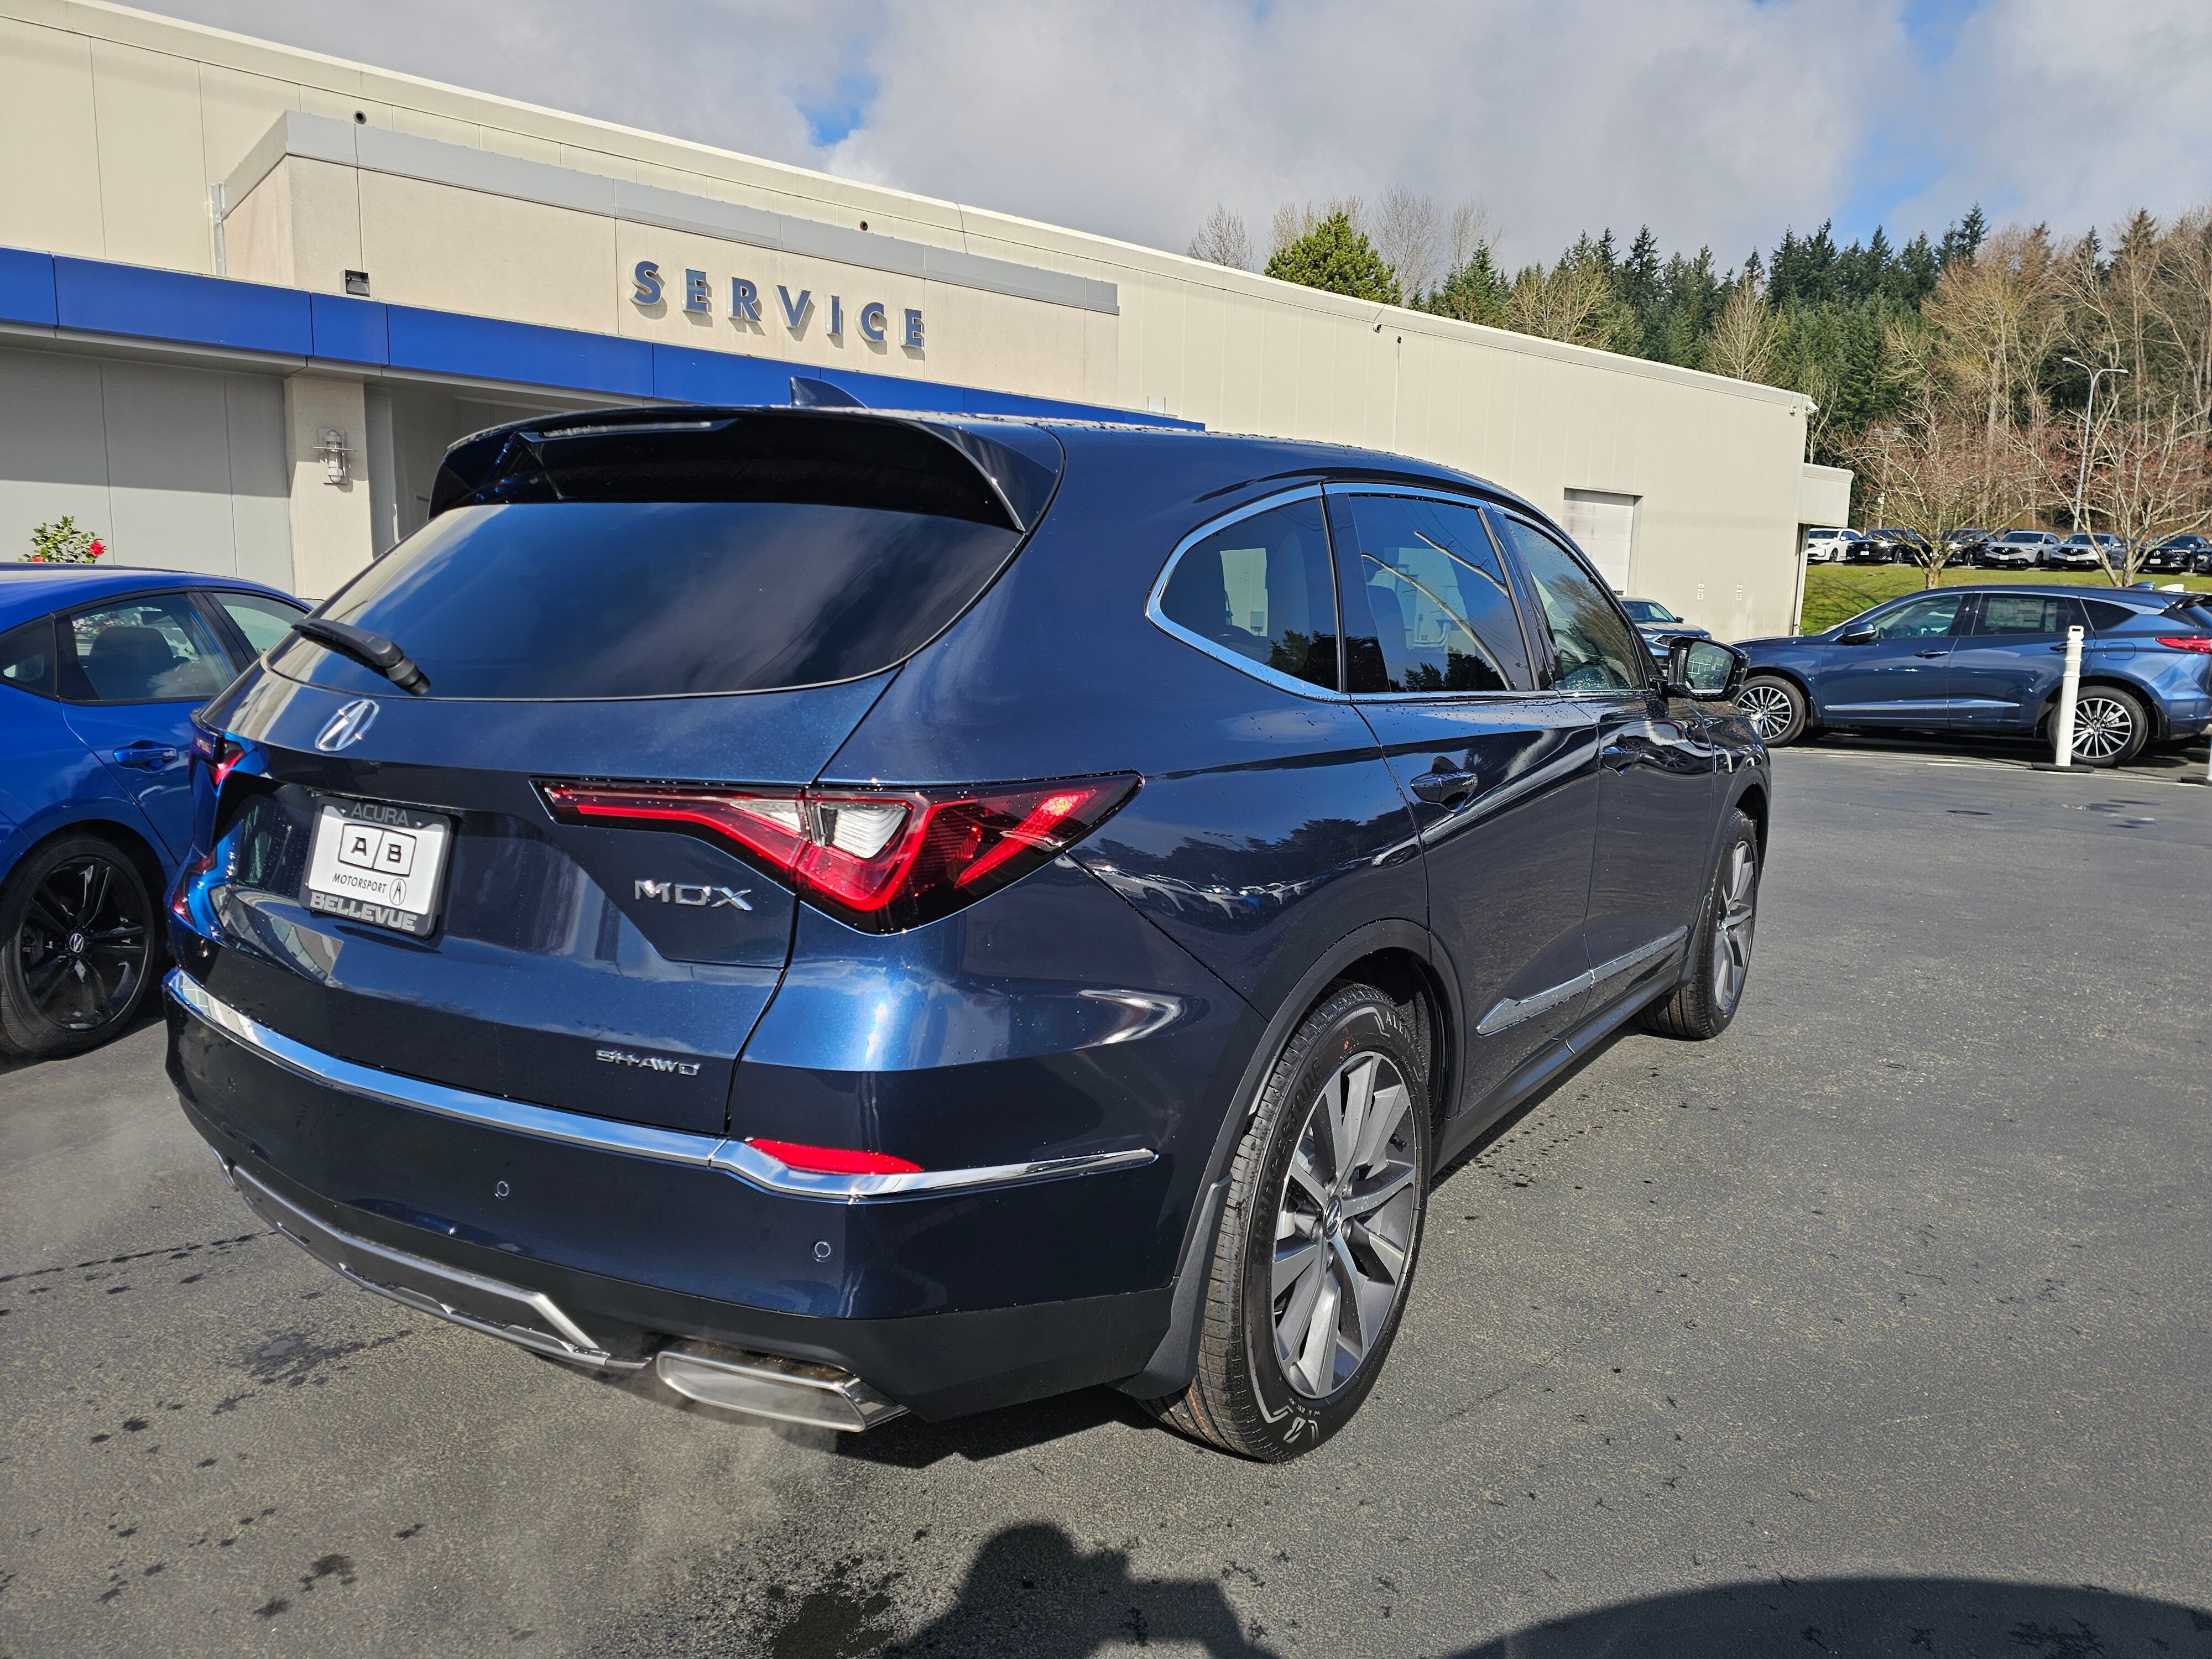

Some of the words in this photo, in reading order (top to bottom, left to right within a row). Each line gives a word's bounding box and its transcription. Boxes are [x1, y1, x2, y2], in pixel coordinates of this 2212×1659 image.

[630, 261, 924, 347] SERVICE
[351, 803, 409, 826] ACURA
[351, 837, 367, 856] A
[387, 843, 401, 863] B
[332, 873, 387, 894] MOTORSPORT
[634, 879, 753, 911] MDX
[310, 892, 417, 932] BELLEVUE
[596, 1050, 701, 1076] SH-AWD
